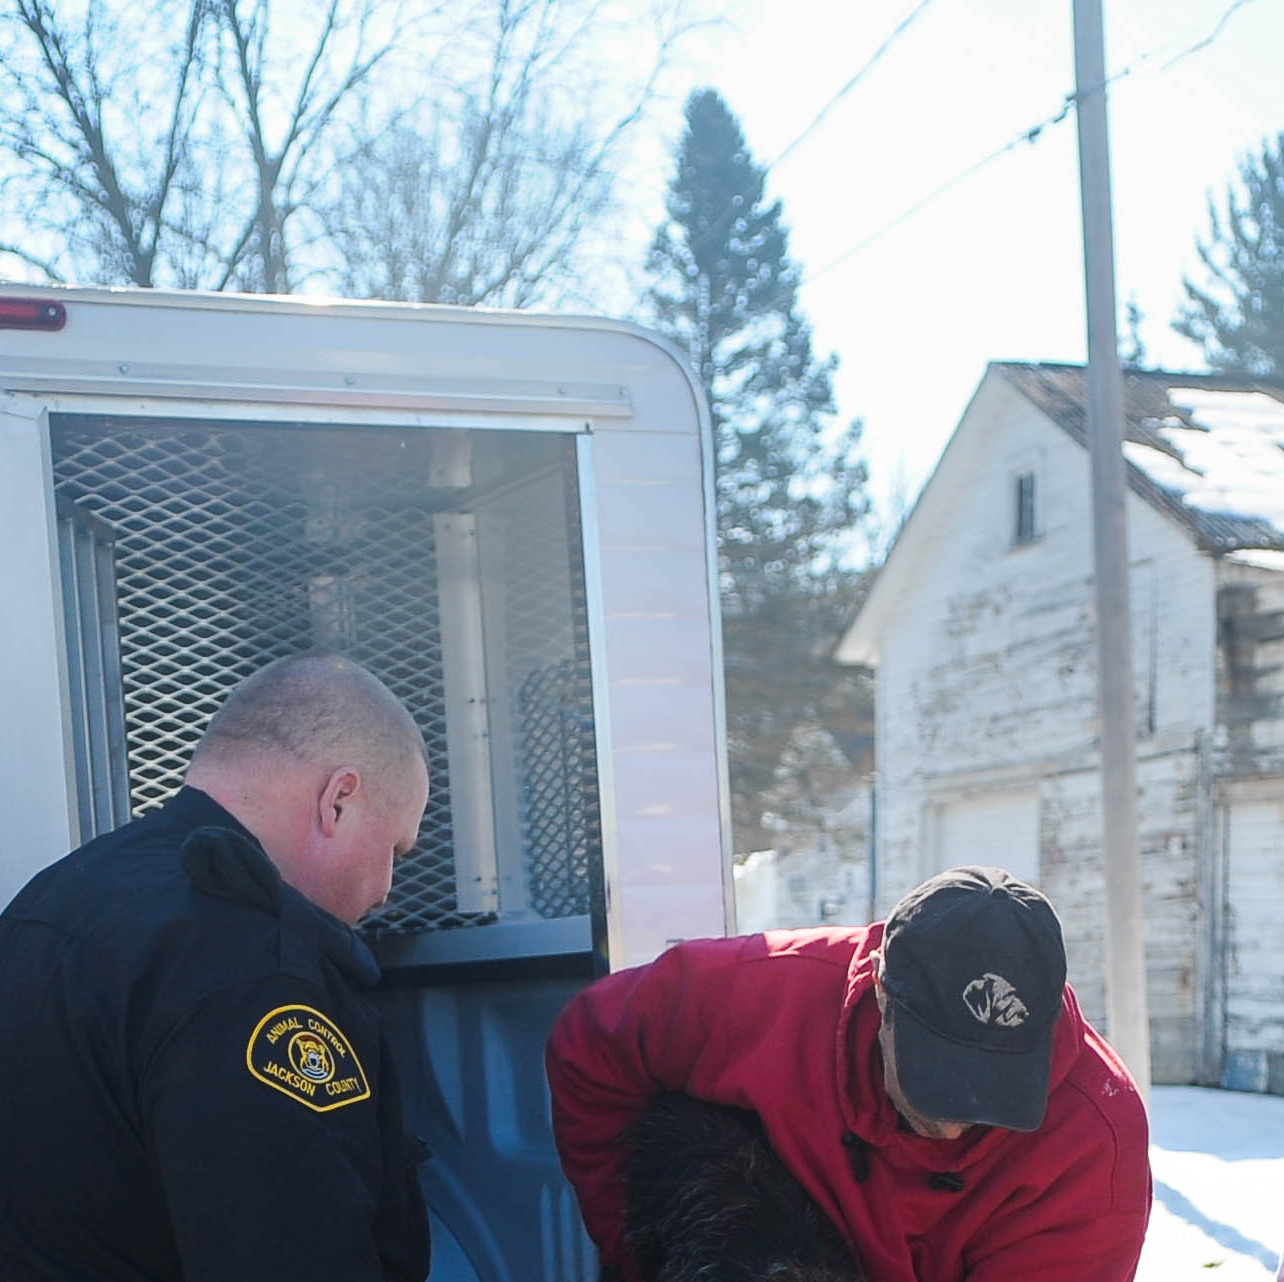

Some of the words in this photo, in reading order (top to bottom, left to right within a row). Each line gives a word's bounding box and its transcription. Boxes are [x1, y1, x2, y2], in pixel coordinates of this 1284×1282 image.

[265, 1016, 303, 1044] ANIMAL
[307, 1018, 347, 1058] CONTROL
[263, 1060, 316, 1097] JACKSON
[325, 1076, 363, 1096] COUNTY
